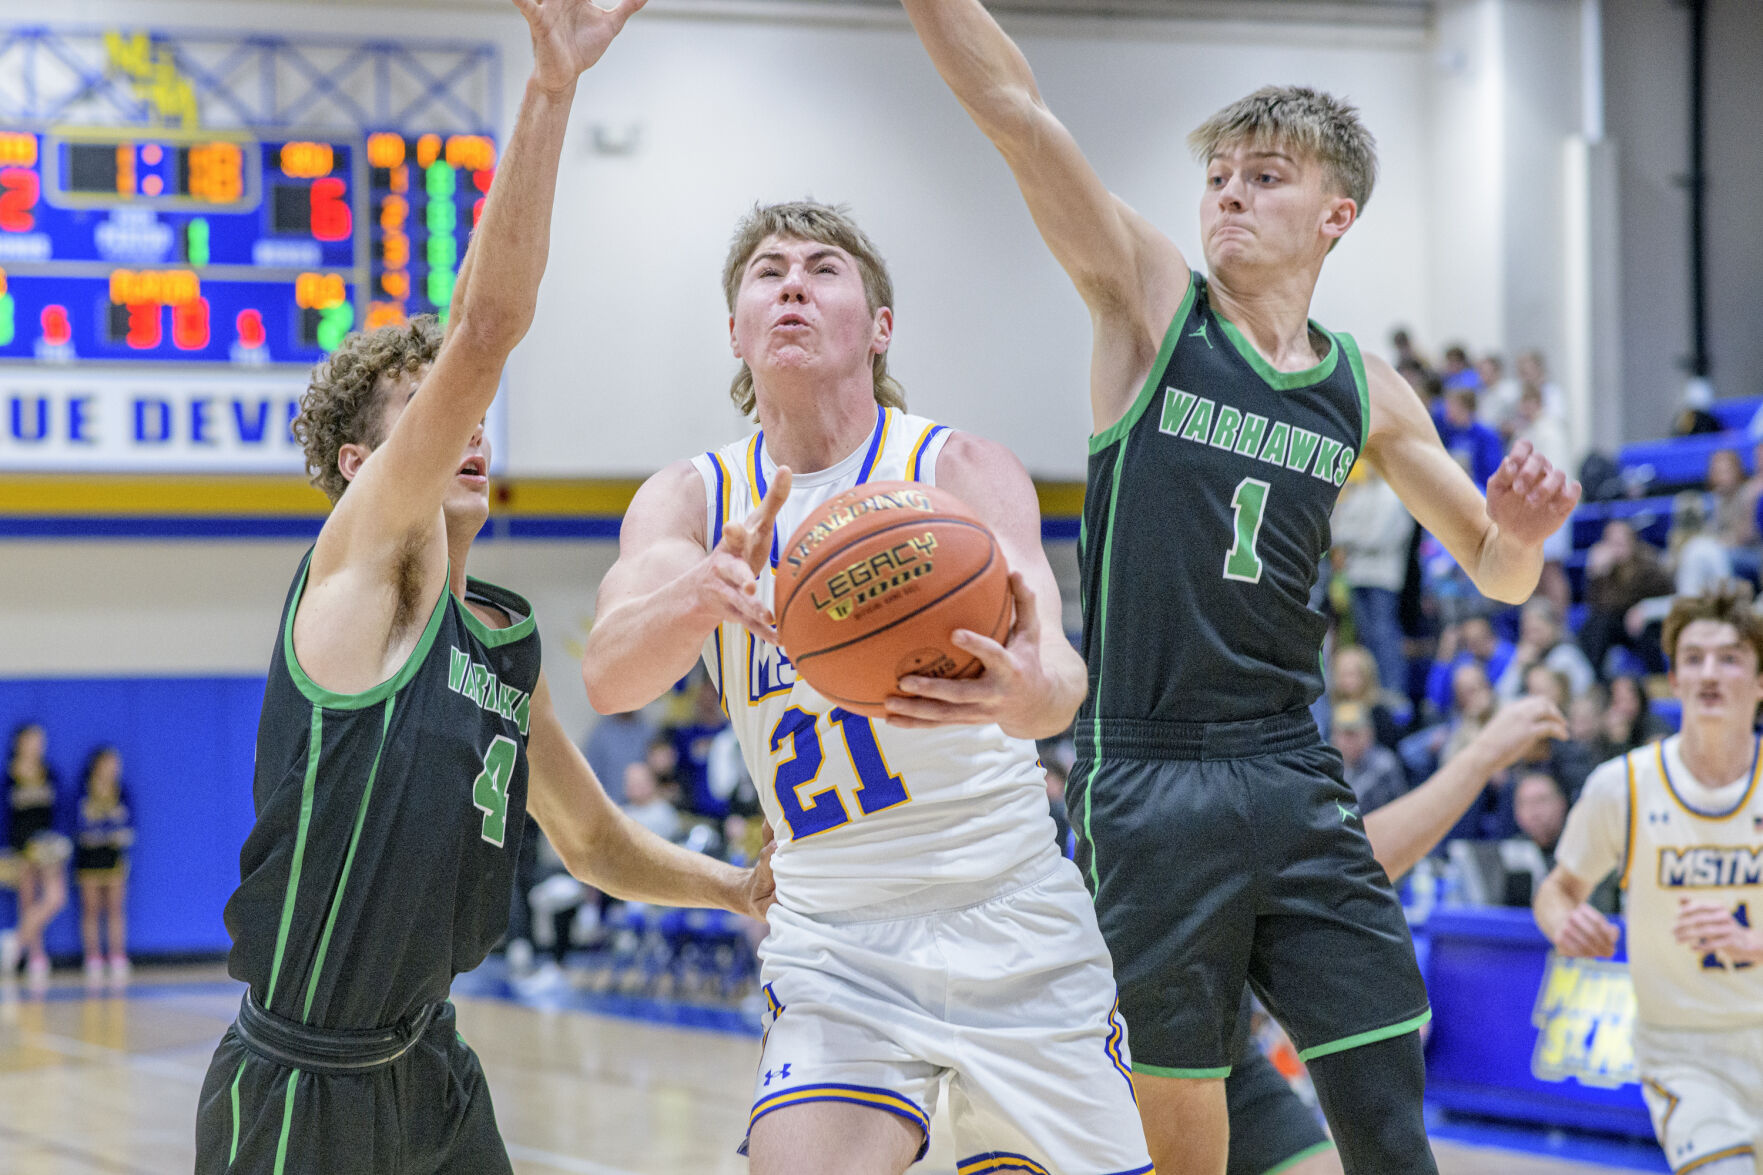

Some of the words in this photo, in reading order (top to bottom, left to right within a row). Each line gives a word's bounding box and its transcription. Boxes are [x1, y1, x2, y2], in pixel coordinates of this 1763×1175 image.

[1158, 386, 1355, 488] WARHAWKS
[788, 489, 935, 577] SPALDING
[810, 532, 938, 611] LEGACY
[1222, 476, 1271, 584] 1
[856, 561, 933, 606] 1000
[473, 733, 518, 848] 4
[768, 704, 912, 843] 21
